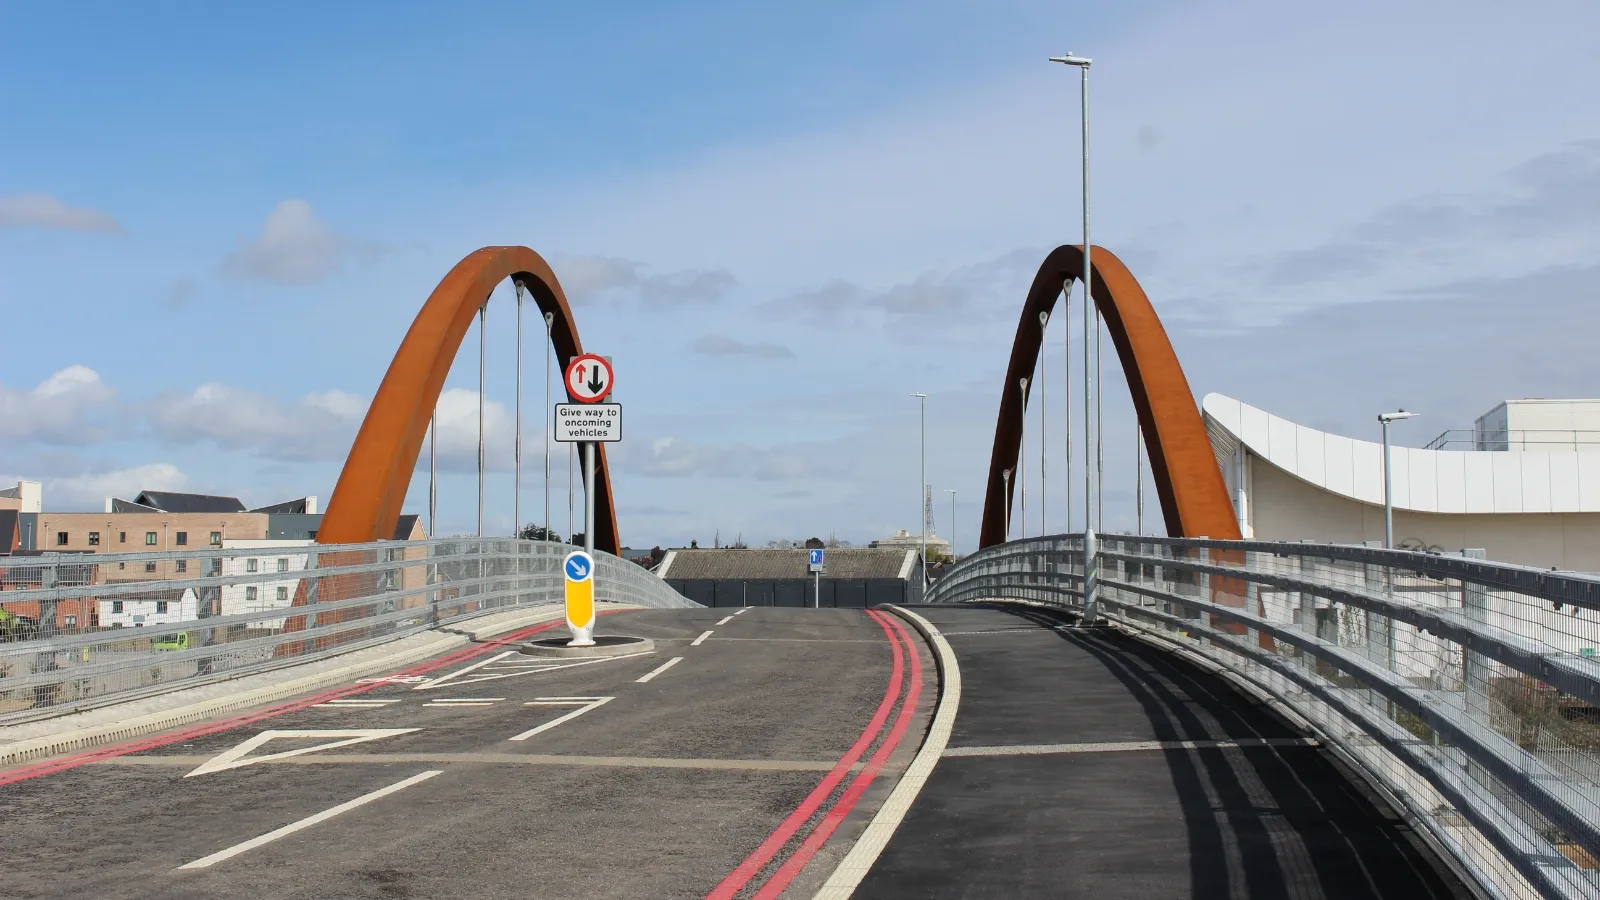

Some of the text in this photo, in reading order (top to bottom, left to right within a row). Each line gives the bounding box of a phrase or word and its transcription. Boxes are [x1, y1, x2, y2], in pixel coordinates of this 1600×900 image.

[560, 408, 581, 416] Give
[607, 408, 617, 416] to
[565, 419, 611, 427] oncoming
